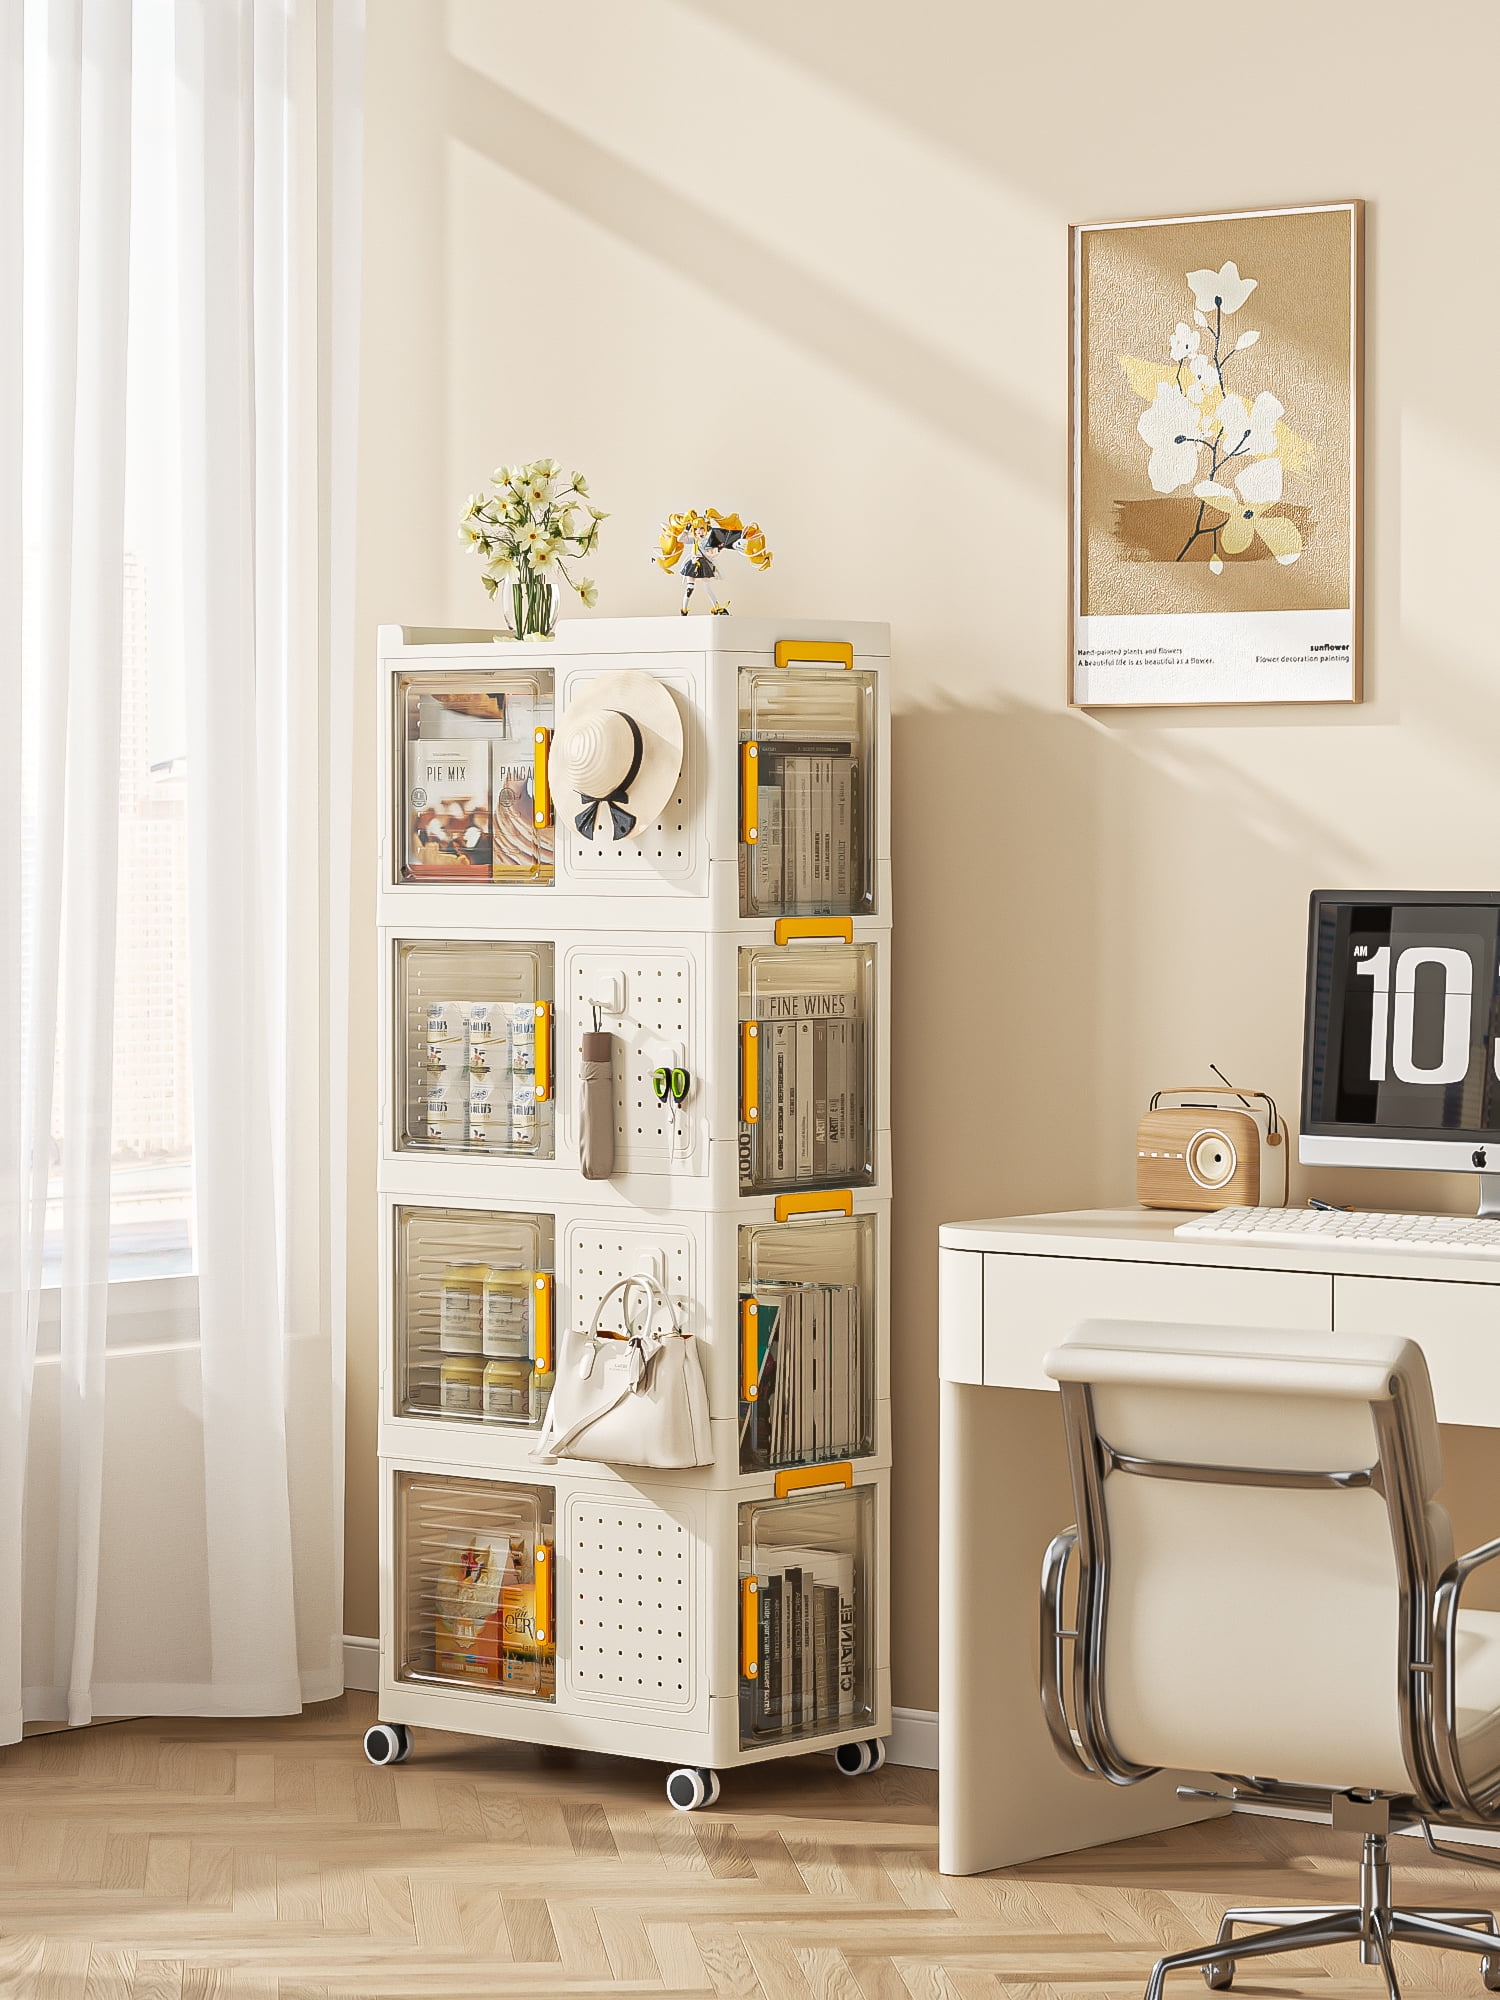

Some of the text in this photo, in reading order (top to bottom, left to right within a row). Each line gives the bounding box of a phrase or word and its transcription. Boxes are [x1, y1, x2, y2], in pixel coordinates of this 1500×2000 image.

[1309, 643, 1350, 652] sunflower
[1144, 658, 1175, 666] beautiful
[1255, 655, 1350, 663] Flower decoration painting
[426, 766, 466, 782] PIE MIX
[500, 766, 535, 782] PANCA
[1353, 945, 1368, 957] AM
[769, 994, 845, 1017] FINE WINES
[1356, 946, 1473, 1085] 10
[739, 1133, 751, 1182] 1000
